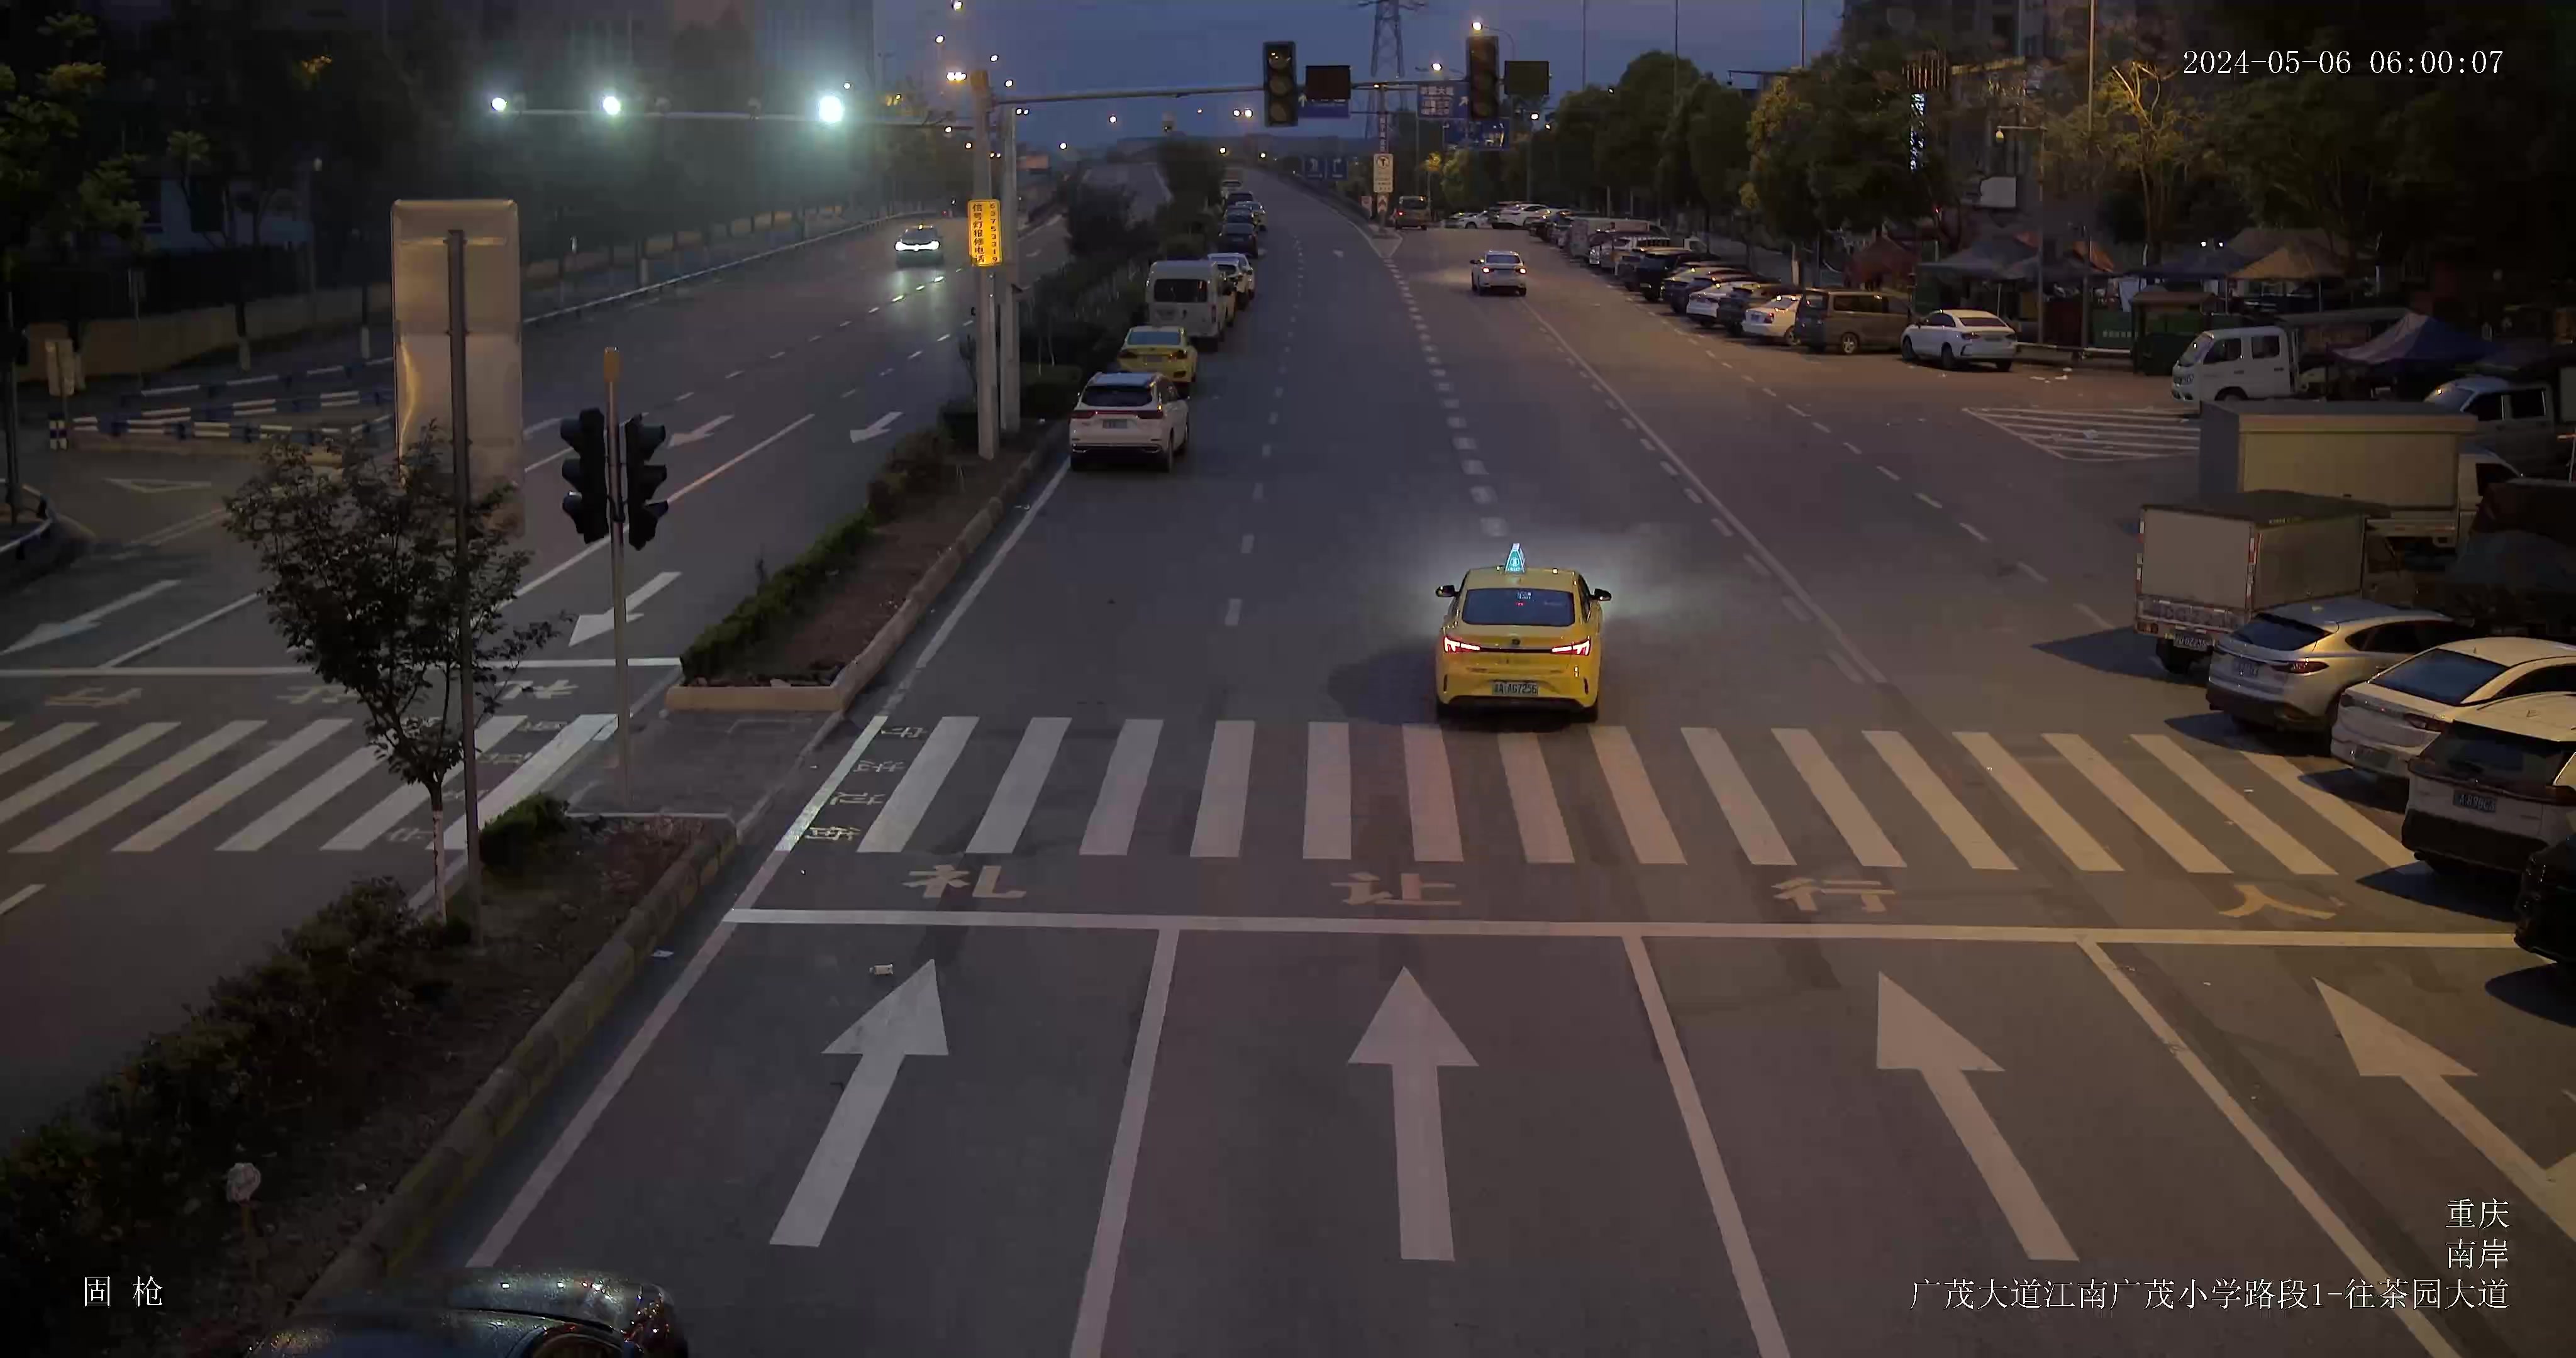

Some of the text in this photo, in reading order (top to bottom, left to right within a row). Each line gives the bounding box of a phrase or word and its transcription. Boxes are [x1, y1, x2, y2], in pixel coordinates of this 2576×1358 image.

[972, 202, 985, 263] 信号灯报修电话
